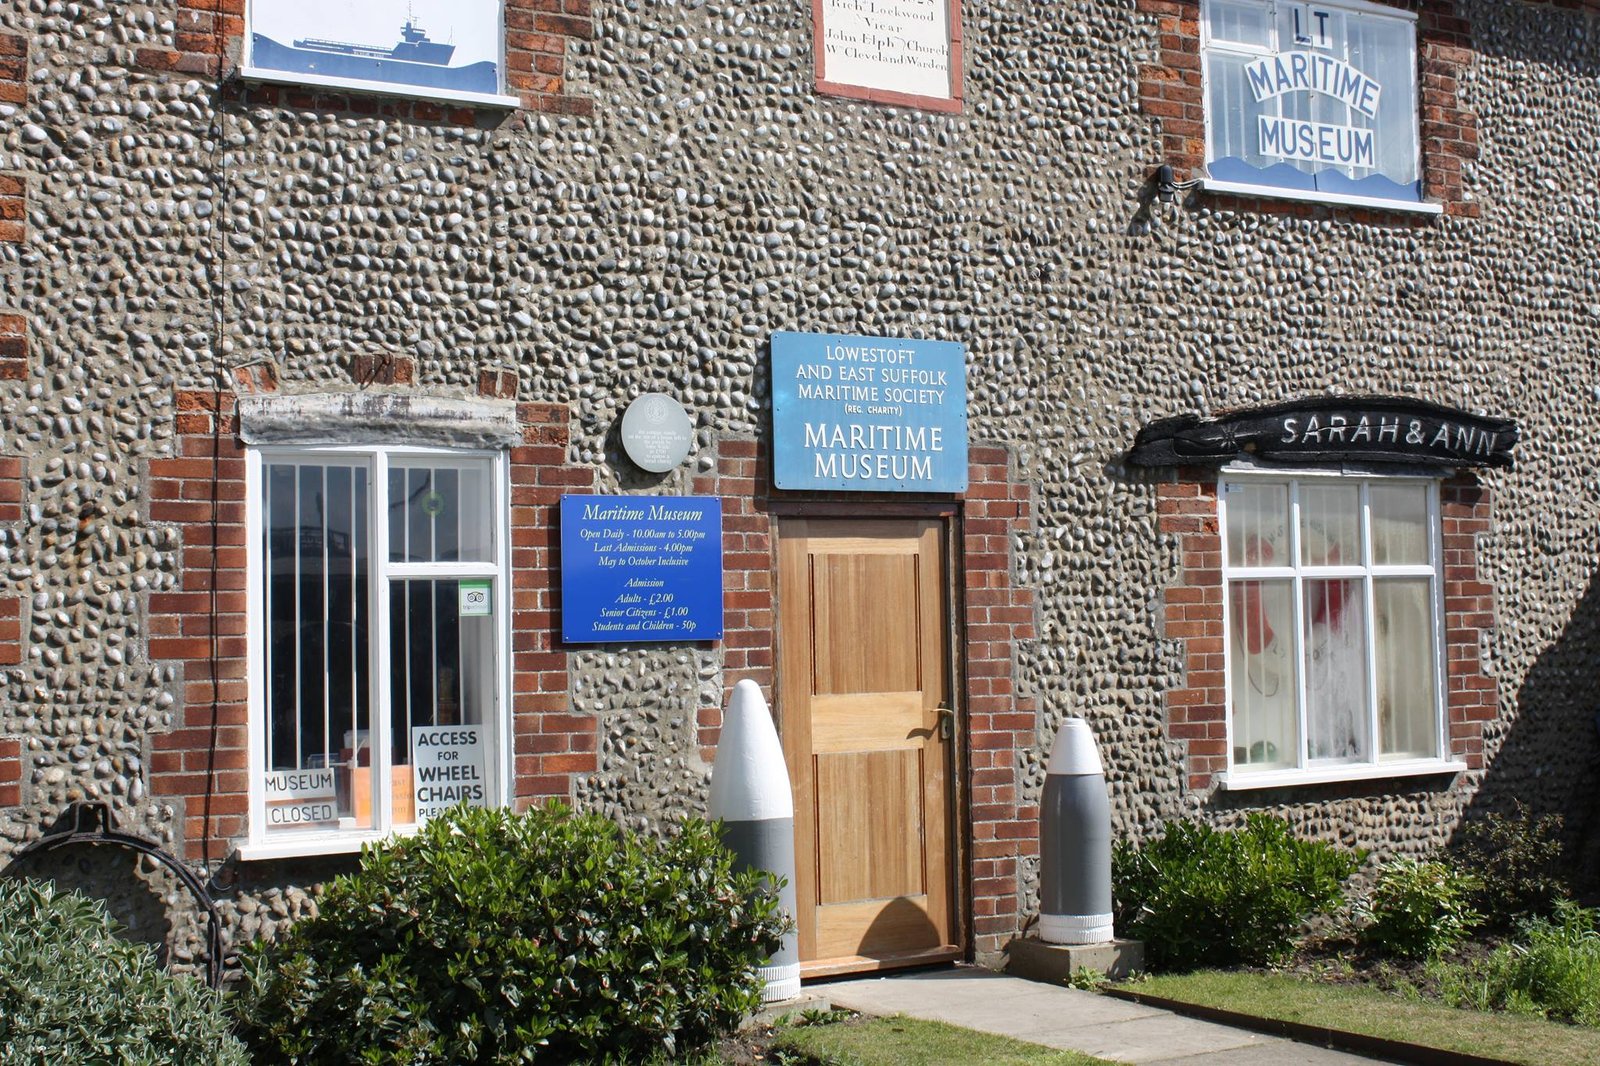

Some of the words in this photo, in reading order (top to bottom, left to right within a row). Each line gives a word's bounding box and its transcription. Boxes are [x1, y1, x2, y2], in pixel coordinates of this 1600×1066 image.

[871, 2, 934, 21] Lockwood
[864, 17, 904, 34] Vicar
[825, 28, 857, 43] John
[862, 33, 895, 51] Elph
[907, 40, 949, 56] Church
[845, 46, 904, 65] Cleveland
[1247, 54, 1380, 117] MARITIME
[1260, 117, 1374, 166] MUSEUM
[826, 345, 915, 365] LOWESTOFT
[796, 365, 832, 380] AND
[839, 366, 876, 382] EAST
[881, 368, 947, 386] SUFFOLK
[798, 384, 879, 402] MARITIME
[884, 387, 945, 404] SOCIETY
[844, 403, 863, 415] (REG.
[867, 404, 902, 417] CHARITY)
[804, 422, 943, 452] MARITIME
[1280, 413, 1400, 445] SARAH
[1429, 423, 1498, 457] ANN
[814, 452, 933, 481] MUSEUM
[582, 504, 645, 521] Maritime
[647, 505, 703, 521] Museum
[580, 529, 600, 540] Open
[603, 529, 624, 540] Daily
[632, 529, 666, 539] 10.00am
[668, 530, 675, 538] to
[677, 530, 706, 541] 5.00pm
[594, 543, 612, 552] Last
[614, 543, 657, 552] Admissions
[663, 543, 693, 554] 4.00pm
[598, 556, 617, 568] May
[619, 557, 626, 566] to
[628, 556, 656, 566] October
[658, 556, 689, 566] Inclusive
[624, 578, 664, 588] Admission
[615, 593, 642, 603] Adults
[649, 593, 674, 605] £2.00
[600, 608, 624, 617] Senior
[626, 607, 656, 619] Citizens
[663, 607, 688, 619] £1.00
[592, 621, 624, 631] Students
[626, 620, 640, 631] and
[642, 620, 674, 631] Children
[681, 620, 697, 632] 50p
[418, 731, 477, 747] ACCESS
[437, 750, 459, 762] FOR
[265, 773, 332, 792] MUSEUM
[418, 765, 480, 782] WHEEL
[417, 784, 483, 803] CHAIRS
[271, 804, 332, 823] CLOSED
